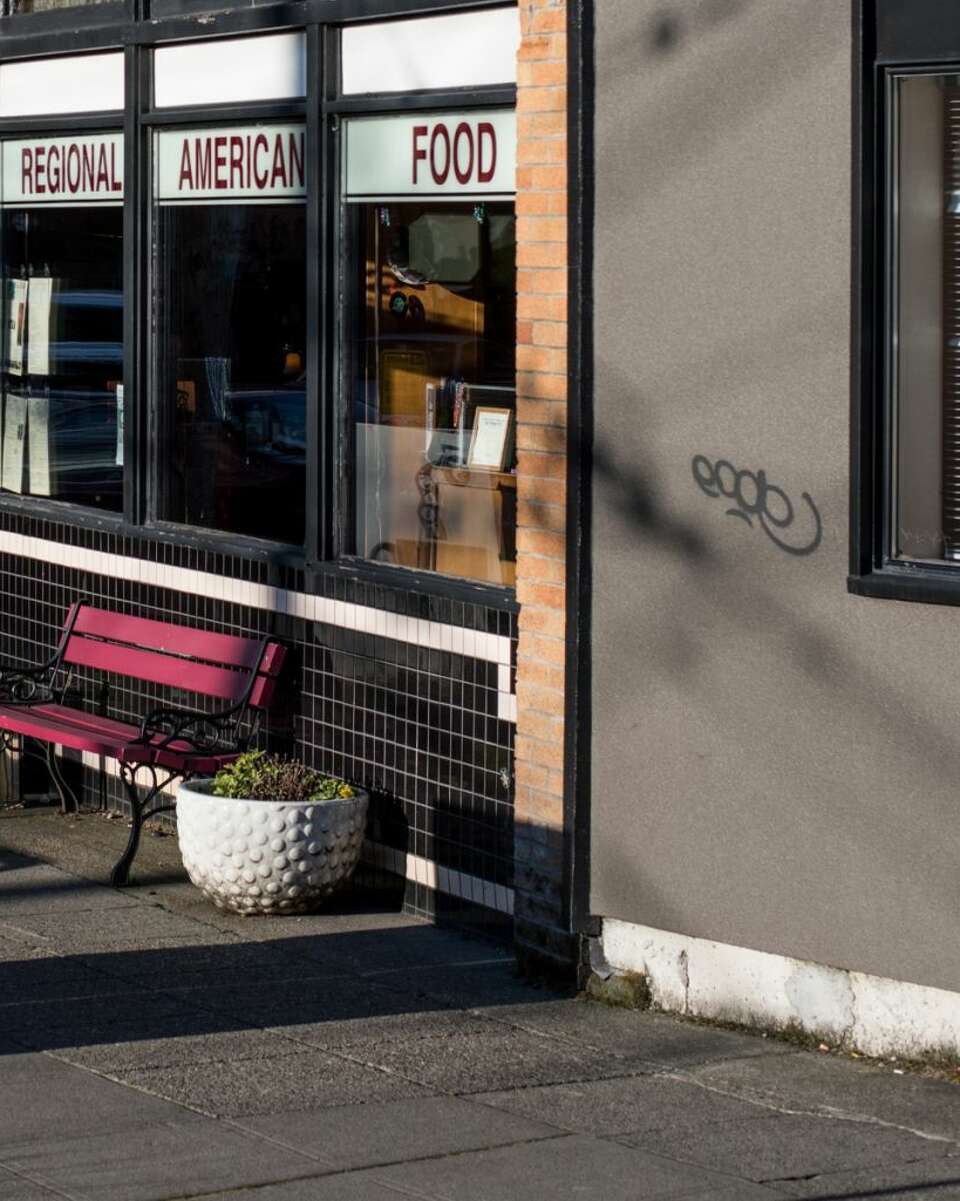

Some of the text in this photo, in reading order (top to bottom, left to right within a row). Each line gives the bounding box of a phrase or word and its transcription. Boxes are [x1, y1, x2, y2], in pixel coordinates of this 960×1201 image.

[21, 142, 123, 195] REGIONAL
[178, 131, 305, 191] AMERICAN
[411, 120, 498, 186] FOOD
